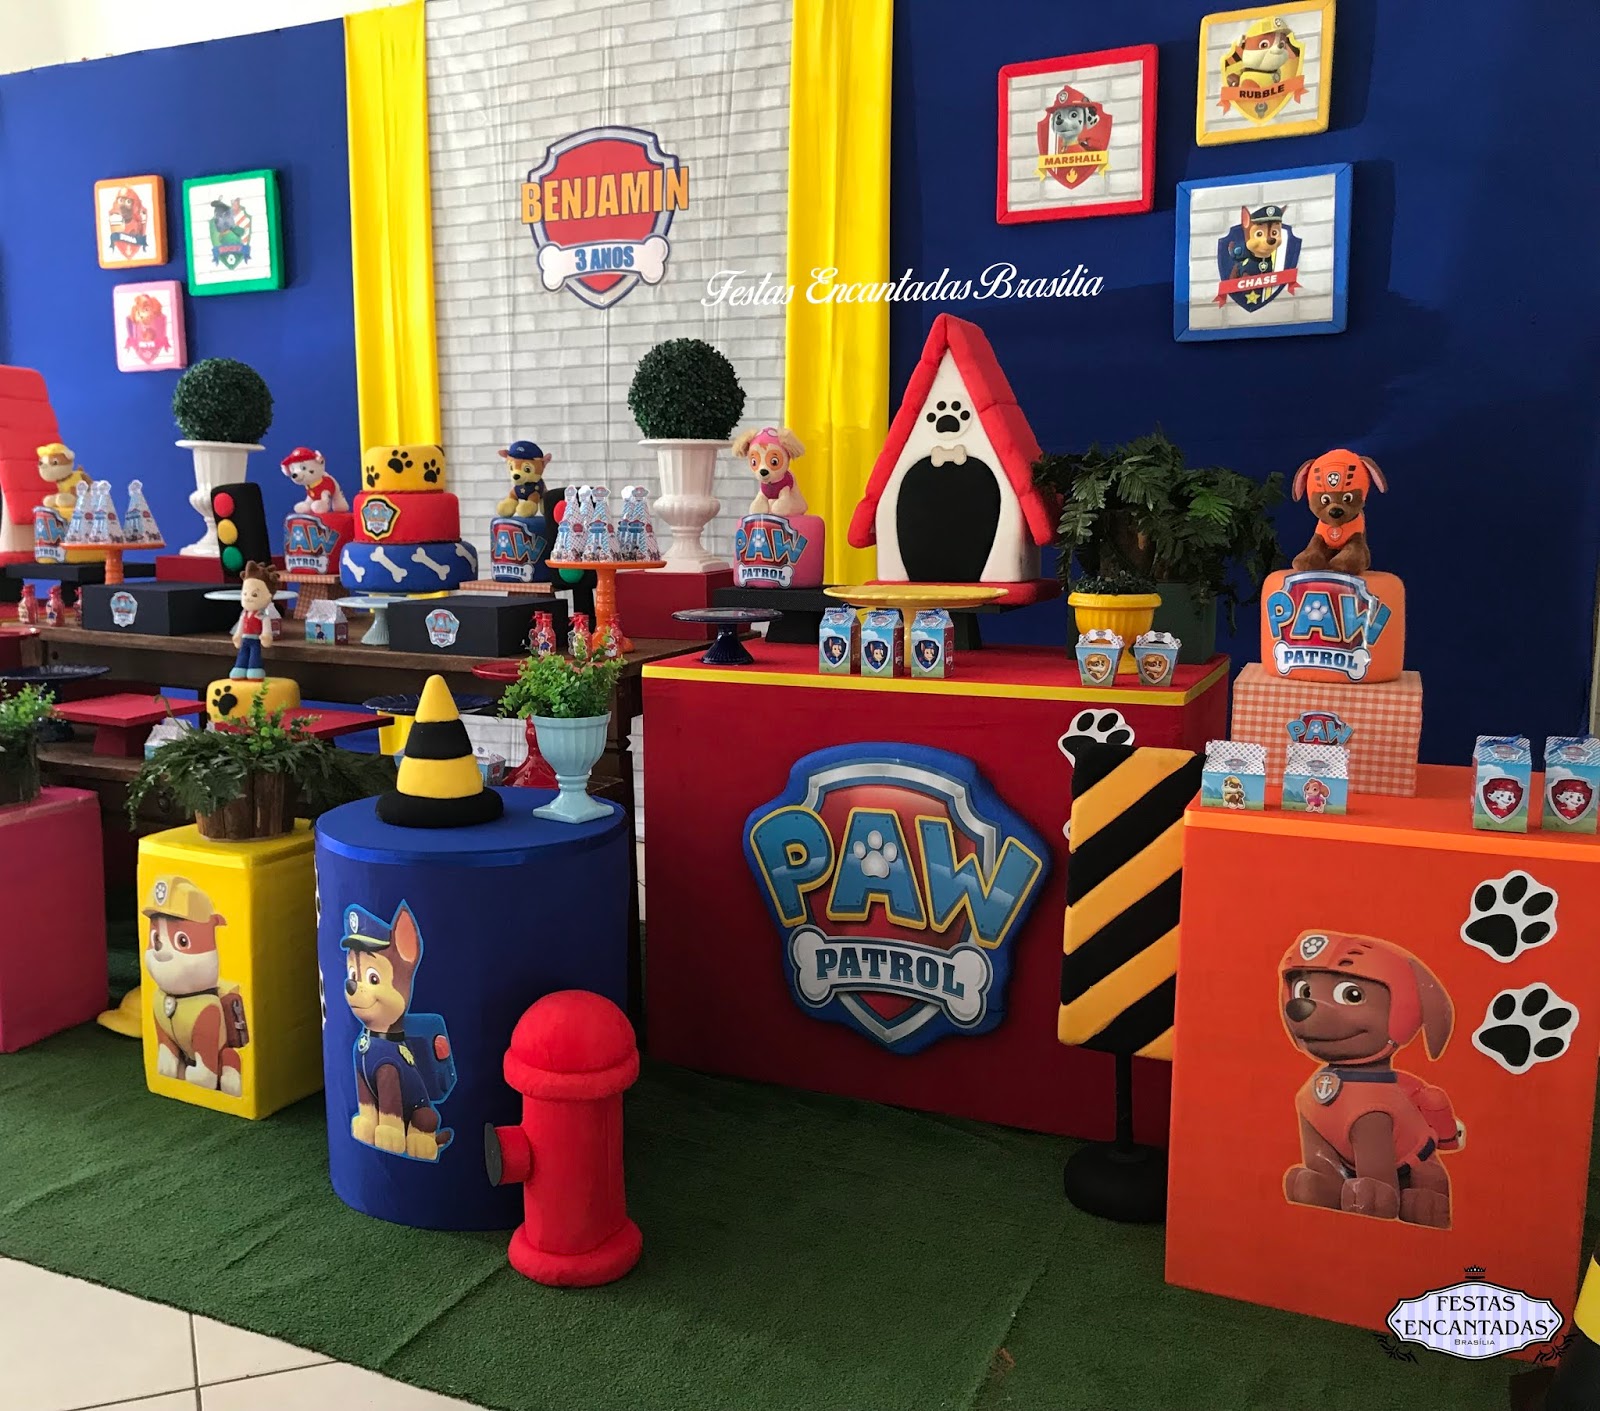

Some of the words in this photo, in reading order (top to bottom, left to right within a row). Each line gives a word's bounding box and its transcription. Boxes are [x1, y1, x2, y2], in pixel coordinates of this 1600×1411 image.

[1238, 83, 1286, 99] RUBBLE
[1044, 153, 1102, 166] MARSHALL
[521, 166, 689, 224] BENJAMIN
[575, 249, 587, 271] 3
[590, 246, 634, 270] ANOS
[1237, 275, 1278, 288] CHASE
[284, 524, 340, 555] AW
[491, 529, 547, 564] AW
[735, 527, 808, 565] PAW
[742, 568, 786, 580] PATROL
[1266, 591, 1392, 646] PAW
[1284, 650, 1358, 669] PATROL
[1286, 719, 1354, 746] PAW
[750, 805, 1043, 950] PAW
[815, 947, 966, 999] PATROL
